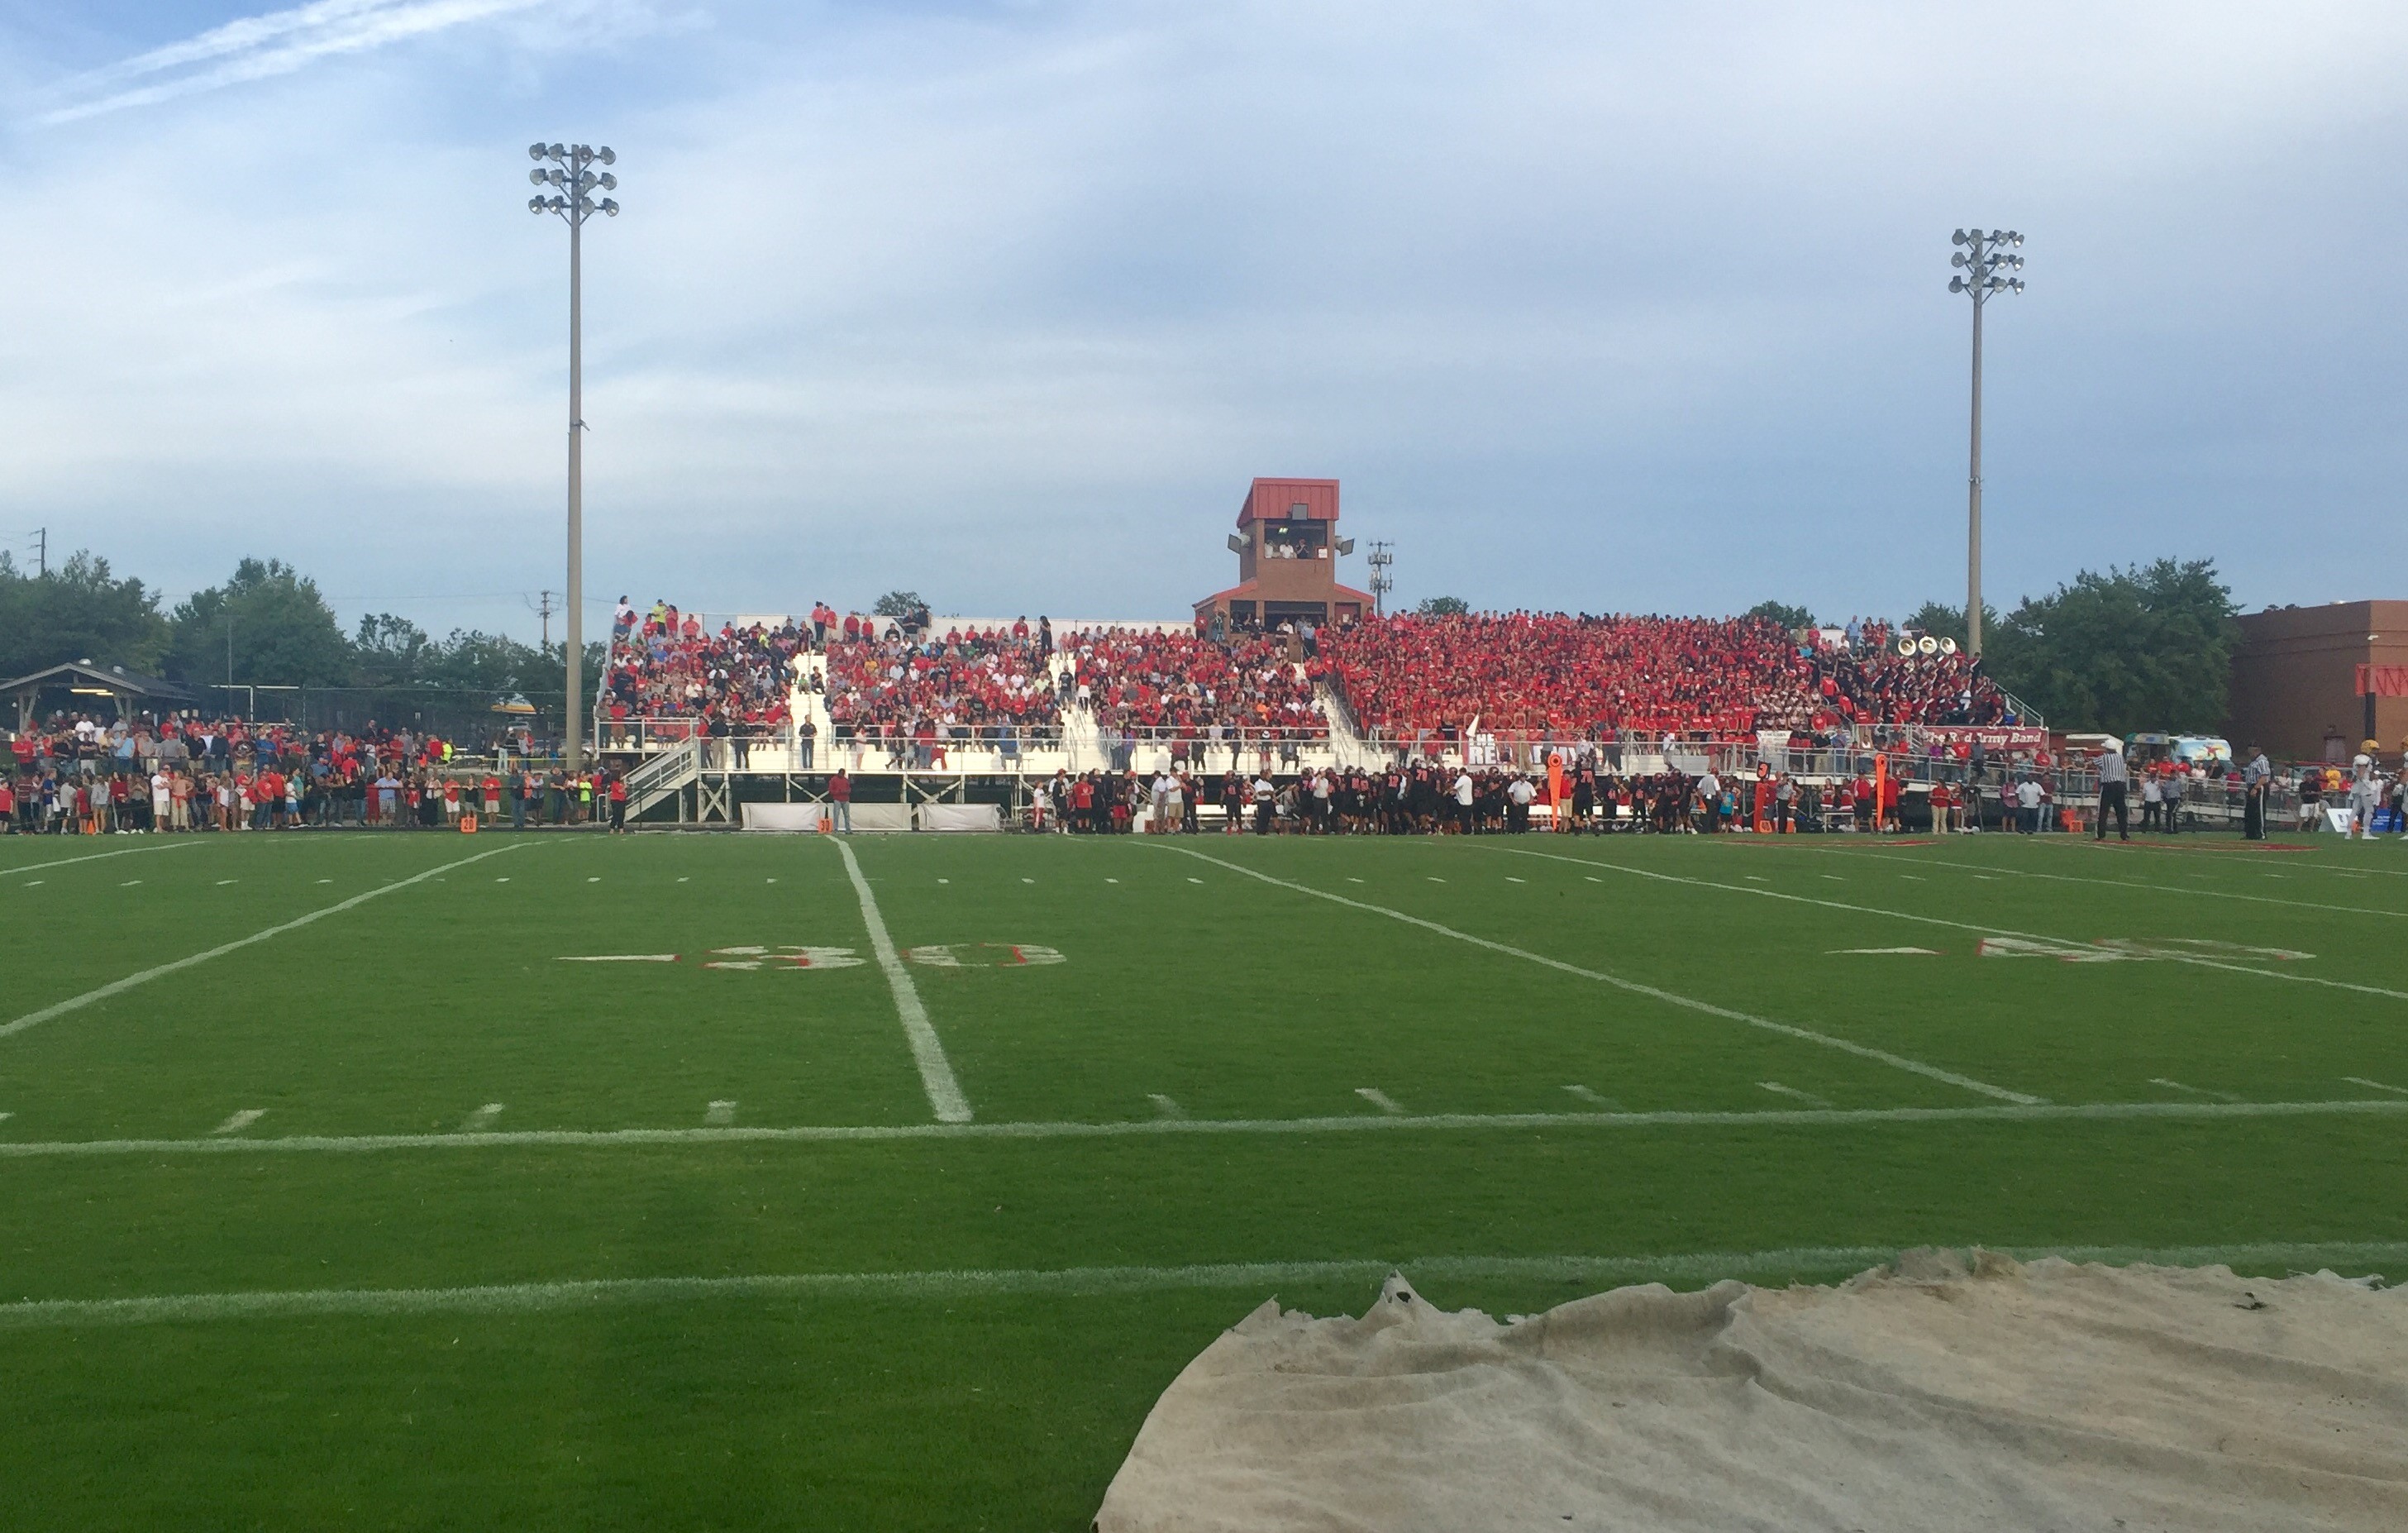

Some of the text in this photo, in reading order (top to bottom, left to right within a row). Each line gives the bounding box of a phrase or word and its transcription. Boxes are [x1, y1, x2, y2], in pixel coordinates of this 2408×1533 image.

[1948, 732, 1973, 743] Rd
[2010, 732, 2042, 743] Band
[1758, 763, 1768, 776] 3
[464, 819, 474, 829] 20
[821, 819, 830, 831] 30
